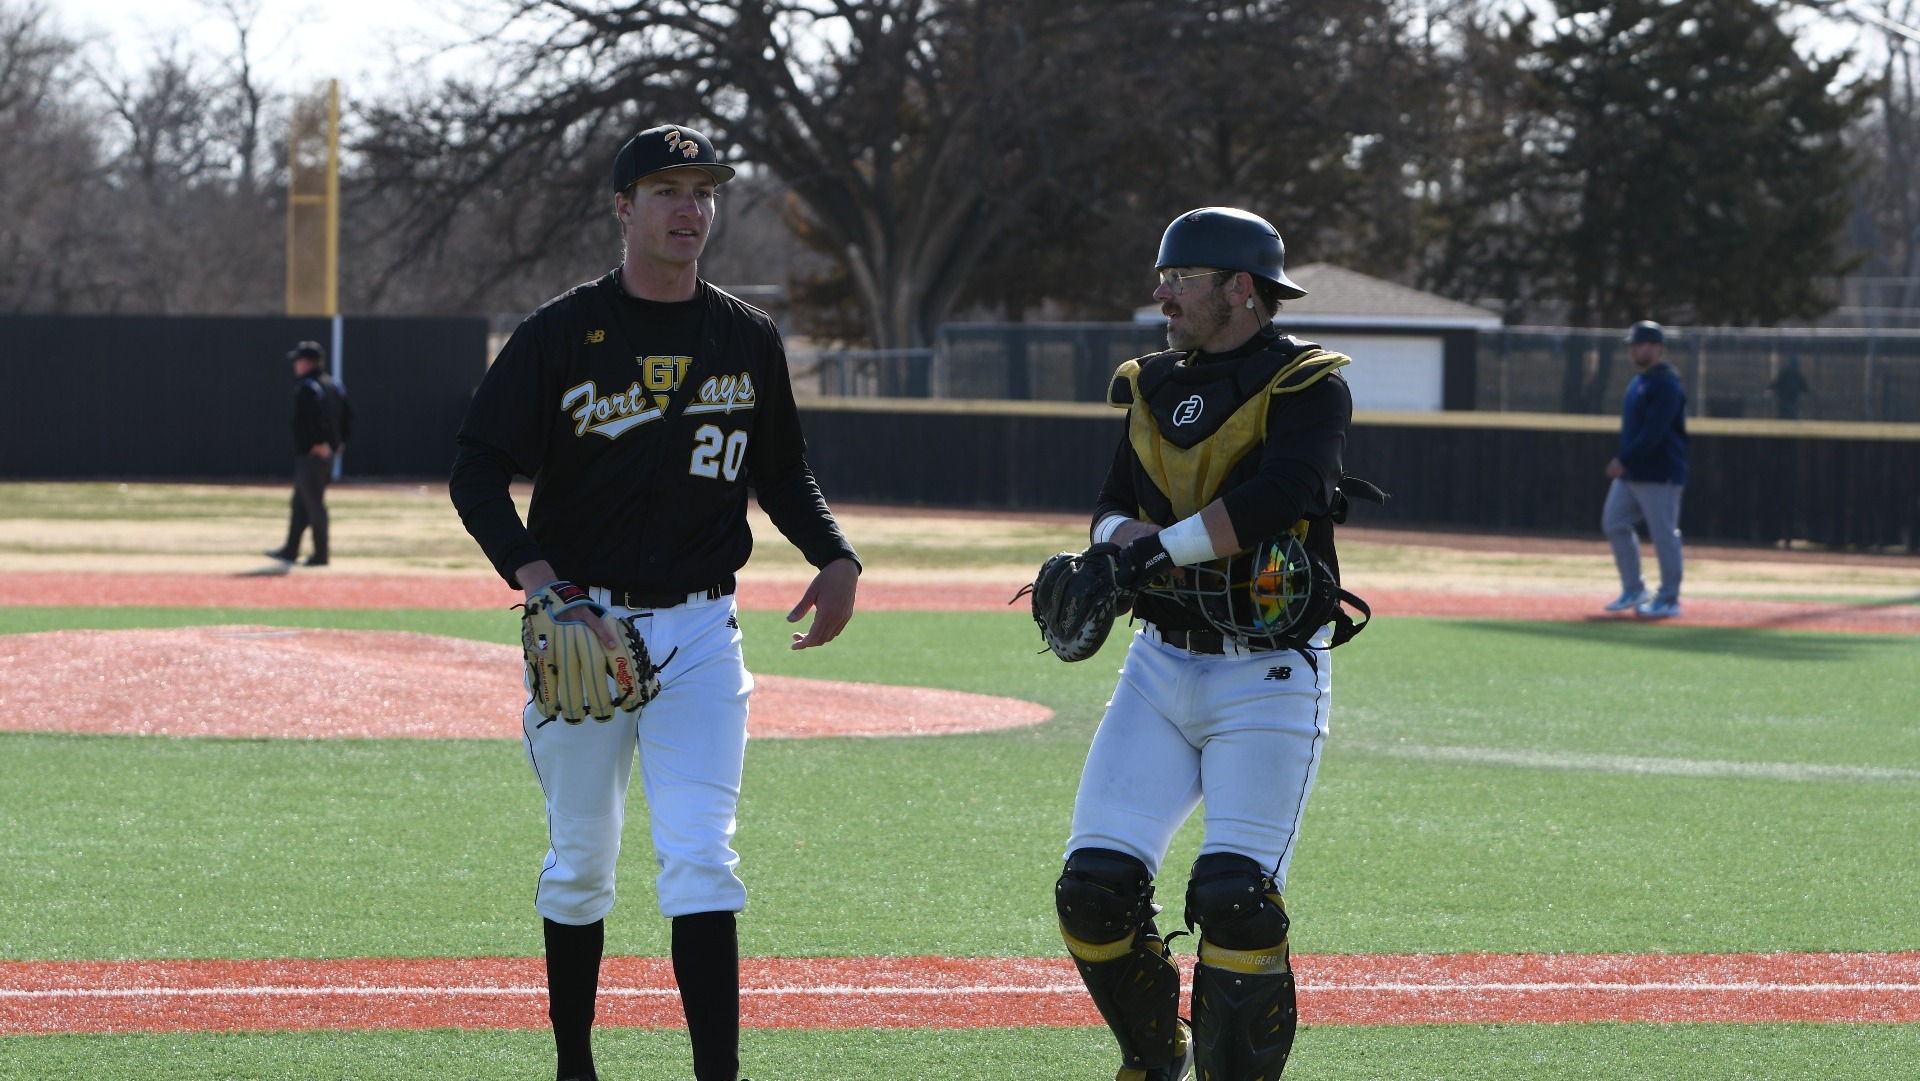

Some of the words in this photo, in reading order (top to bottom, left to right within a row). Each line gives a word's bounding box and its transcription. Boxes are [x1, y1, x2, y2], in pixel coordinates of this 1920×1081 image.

[561, 380, 646, 437] Fort
[698, 371, 756, 415] ays
[689, 423, 748, 483] 20
[1234, 953, 1254, 965] PRO
[1254, 955, 1278, 966] GEAR
